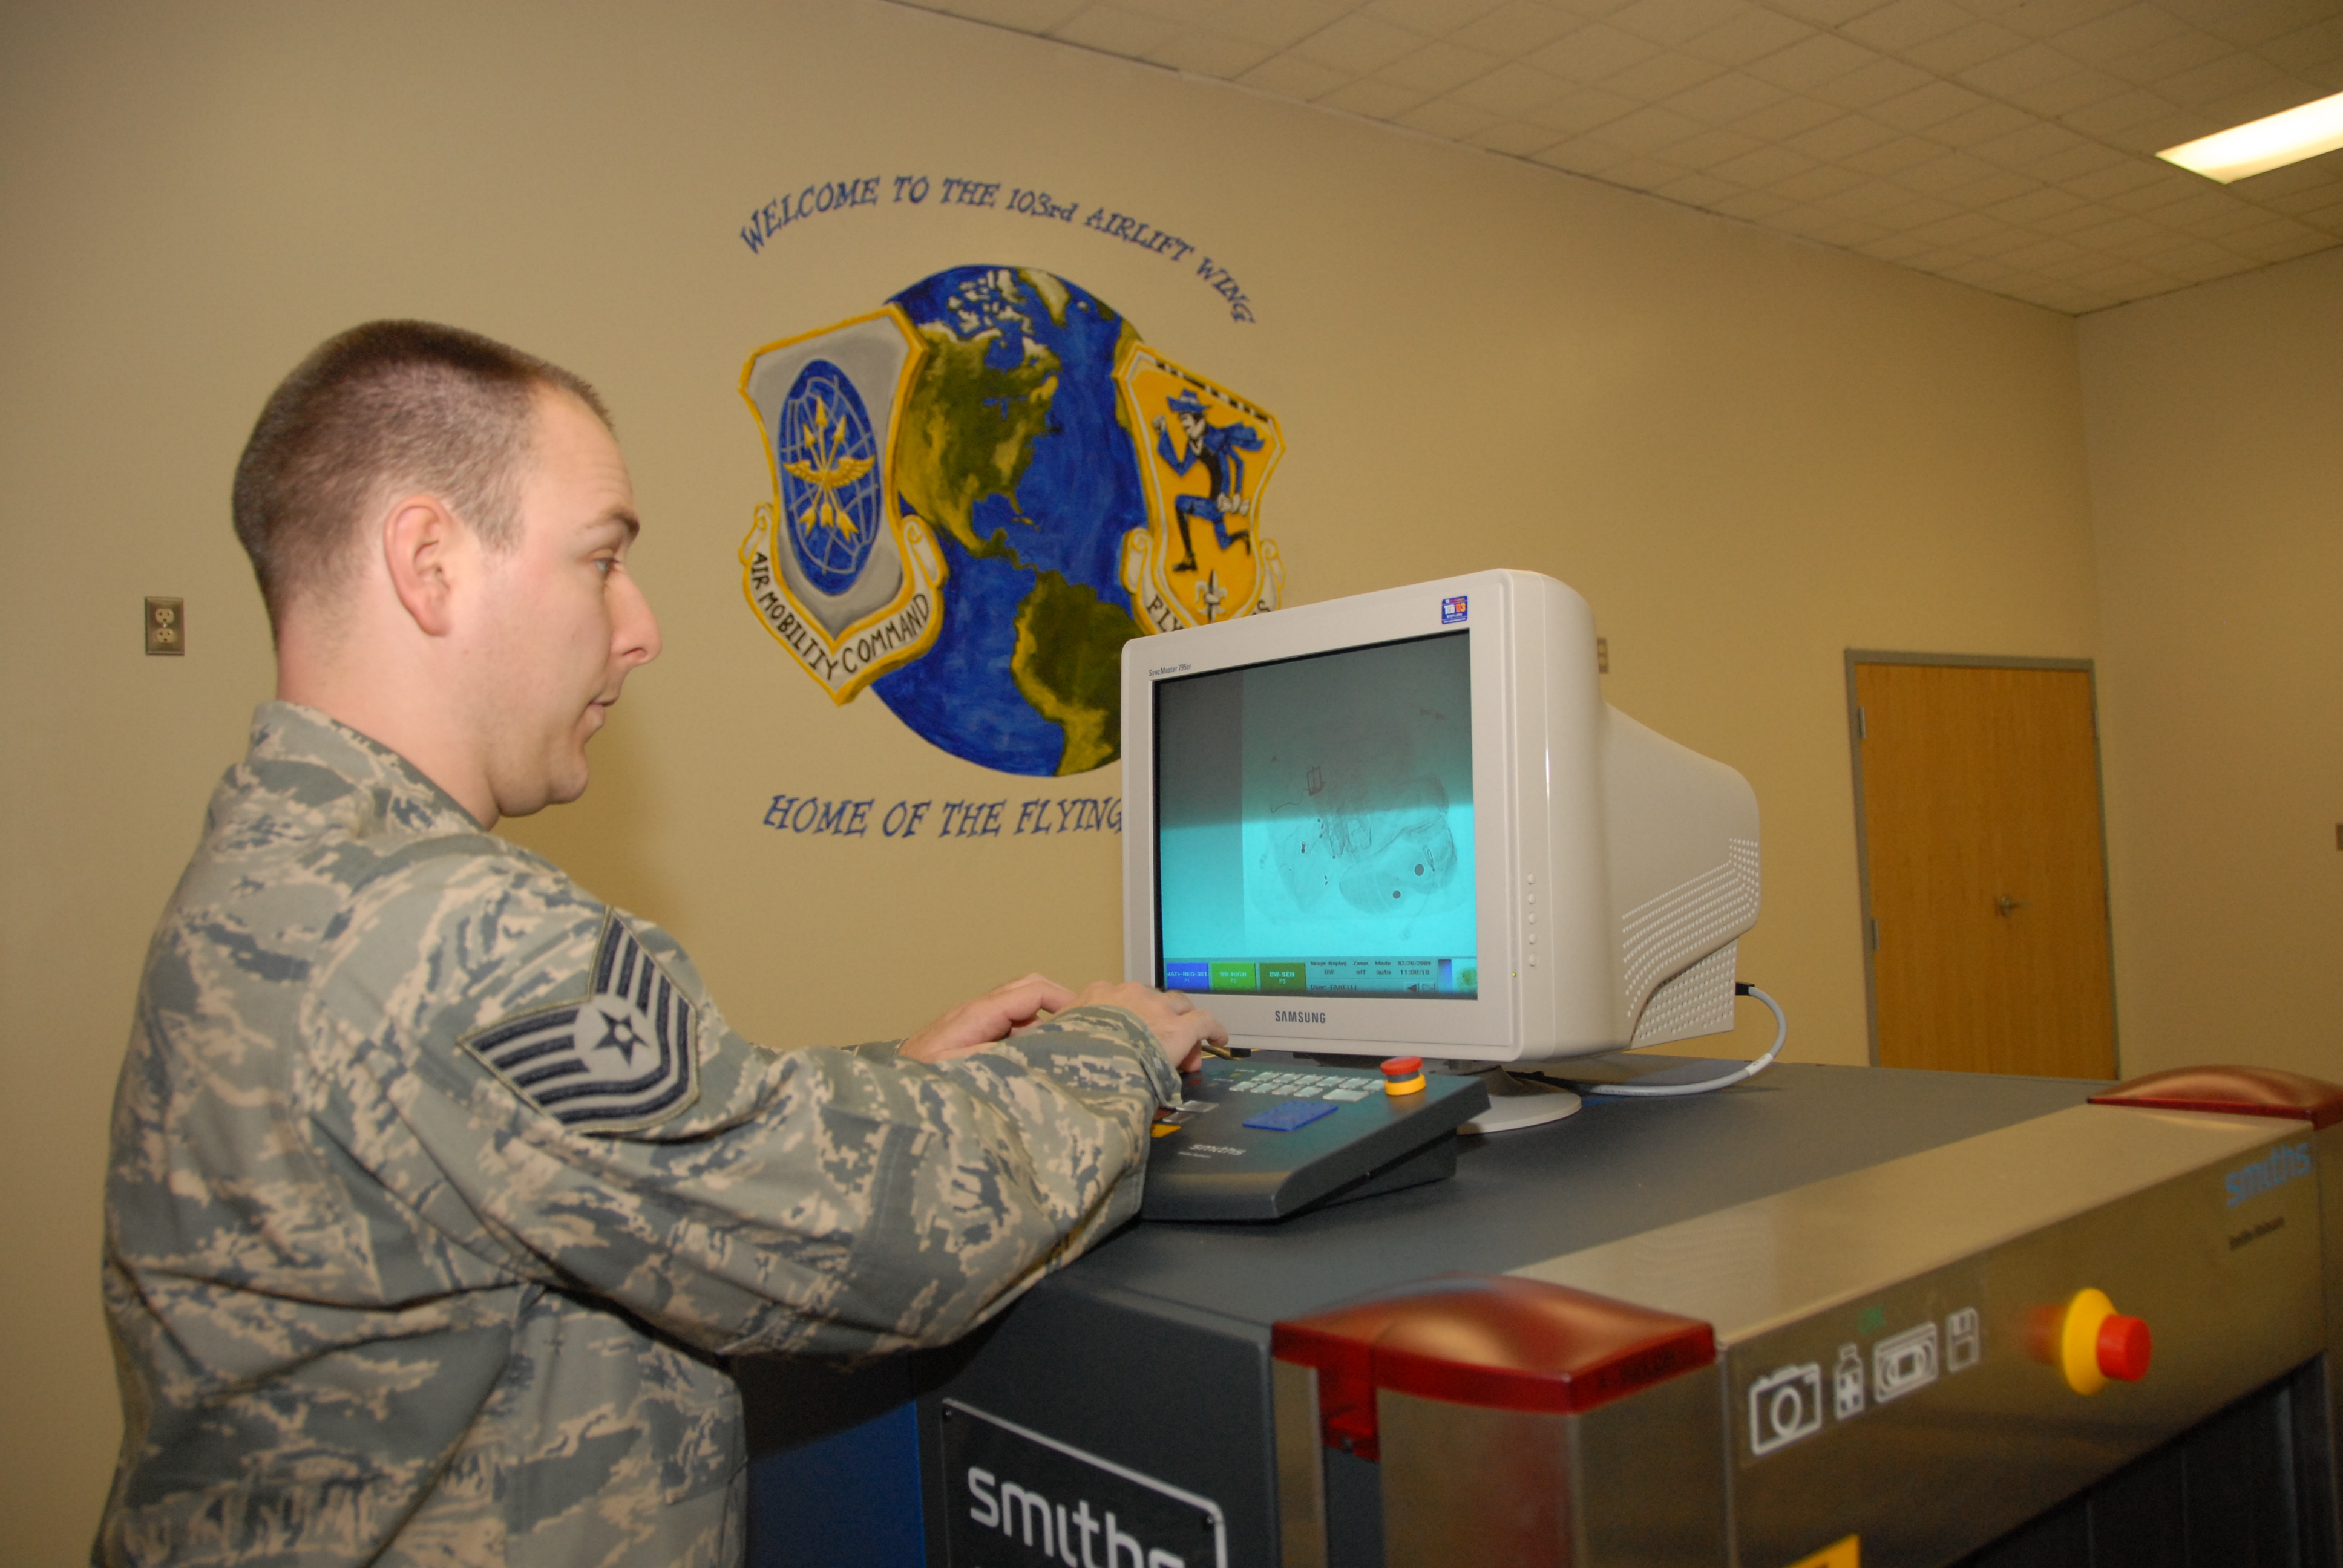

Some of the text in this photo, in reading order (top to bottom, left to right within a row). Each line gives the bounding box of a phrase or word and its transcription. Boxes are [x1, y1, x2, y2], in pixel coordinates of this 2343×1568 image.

[739, 175, 1256, 325] WELCOME TO THE 103rd AIRLIFT WING
[751, 552, 839, 681] AIR MOBILITY
[842, 593, 931, 673] COMMAND
[1149, 667, 1178, 677] SyncMaster
[763, 794, 1122, 838] HOME OF THE FLYING
[1275, 1010, 1326, 1024] SAMSUNG
